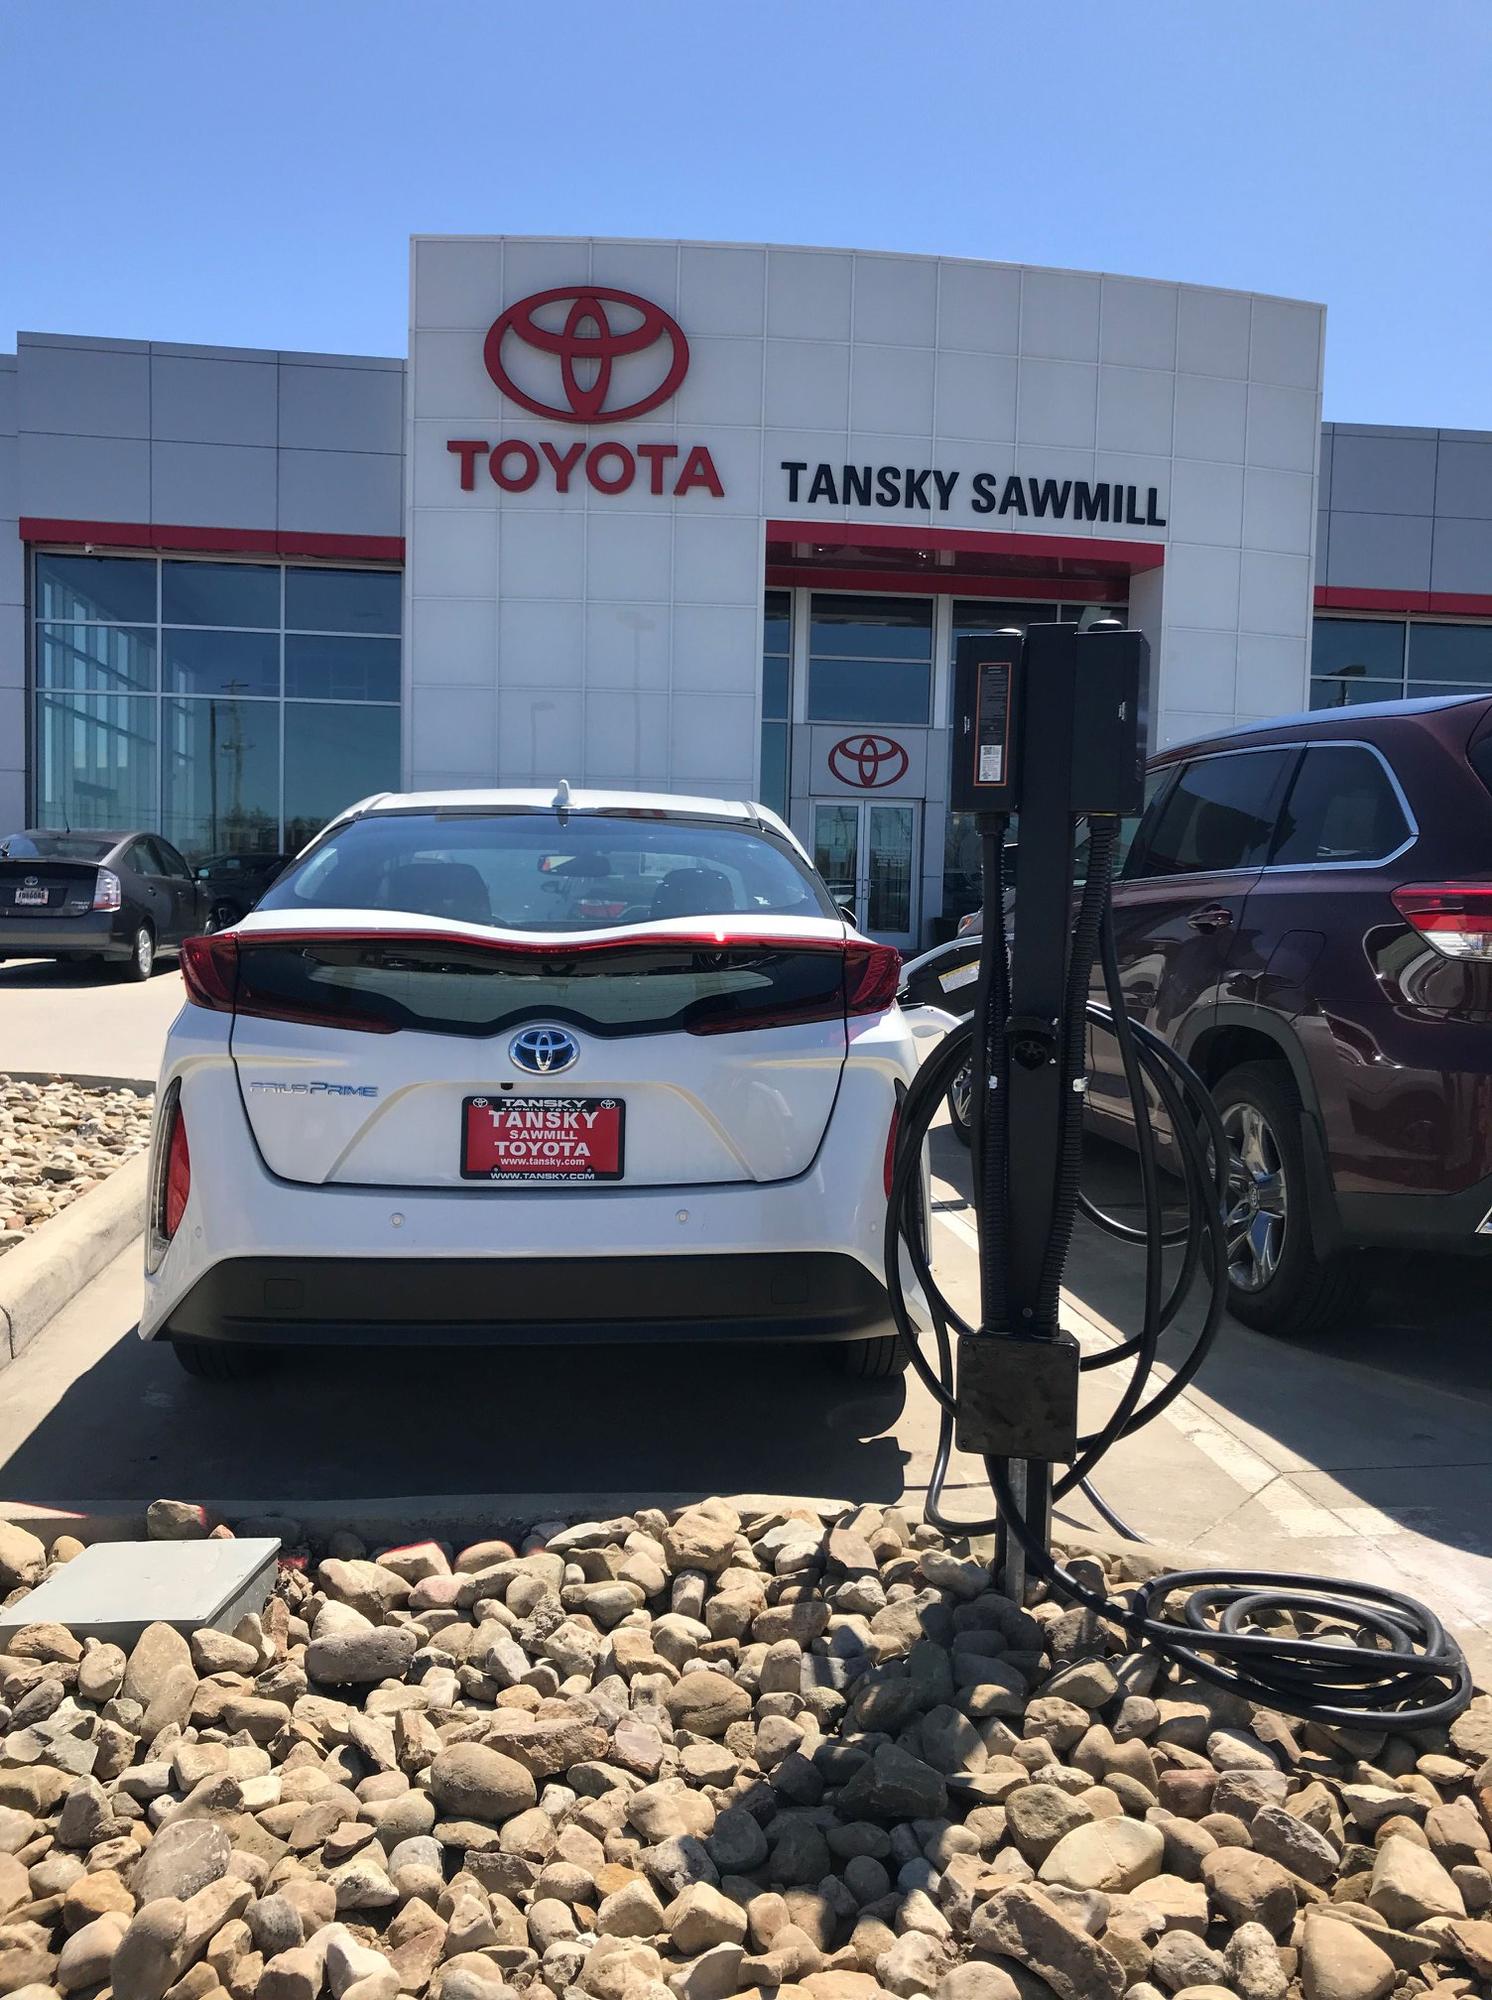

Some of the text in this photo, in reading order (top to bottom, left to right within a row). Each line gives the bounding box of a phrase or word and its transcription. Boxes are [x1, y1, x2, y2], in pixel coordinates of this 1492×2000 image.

[447, 439, 725, 498] TOYOTA
[781, 461, 1167, 527] TANSKY SAWMILL
[501, 1099, 587, 1107] TANSKY
[488, 1111, 598, 1128] TANSKY
[509, 1130, 578, 1139] SAWMILL
[494, 1141, 590, 1156] TOYOTA
[501, 1157, 585, 1167] www.tansky.com
[490, 1172, 595, 1180] WWW.TANSKY.COM
